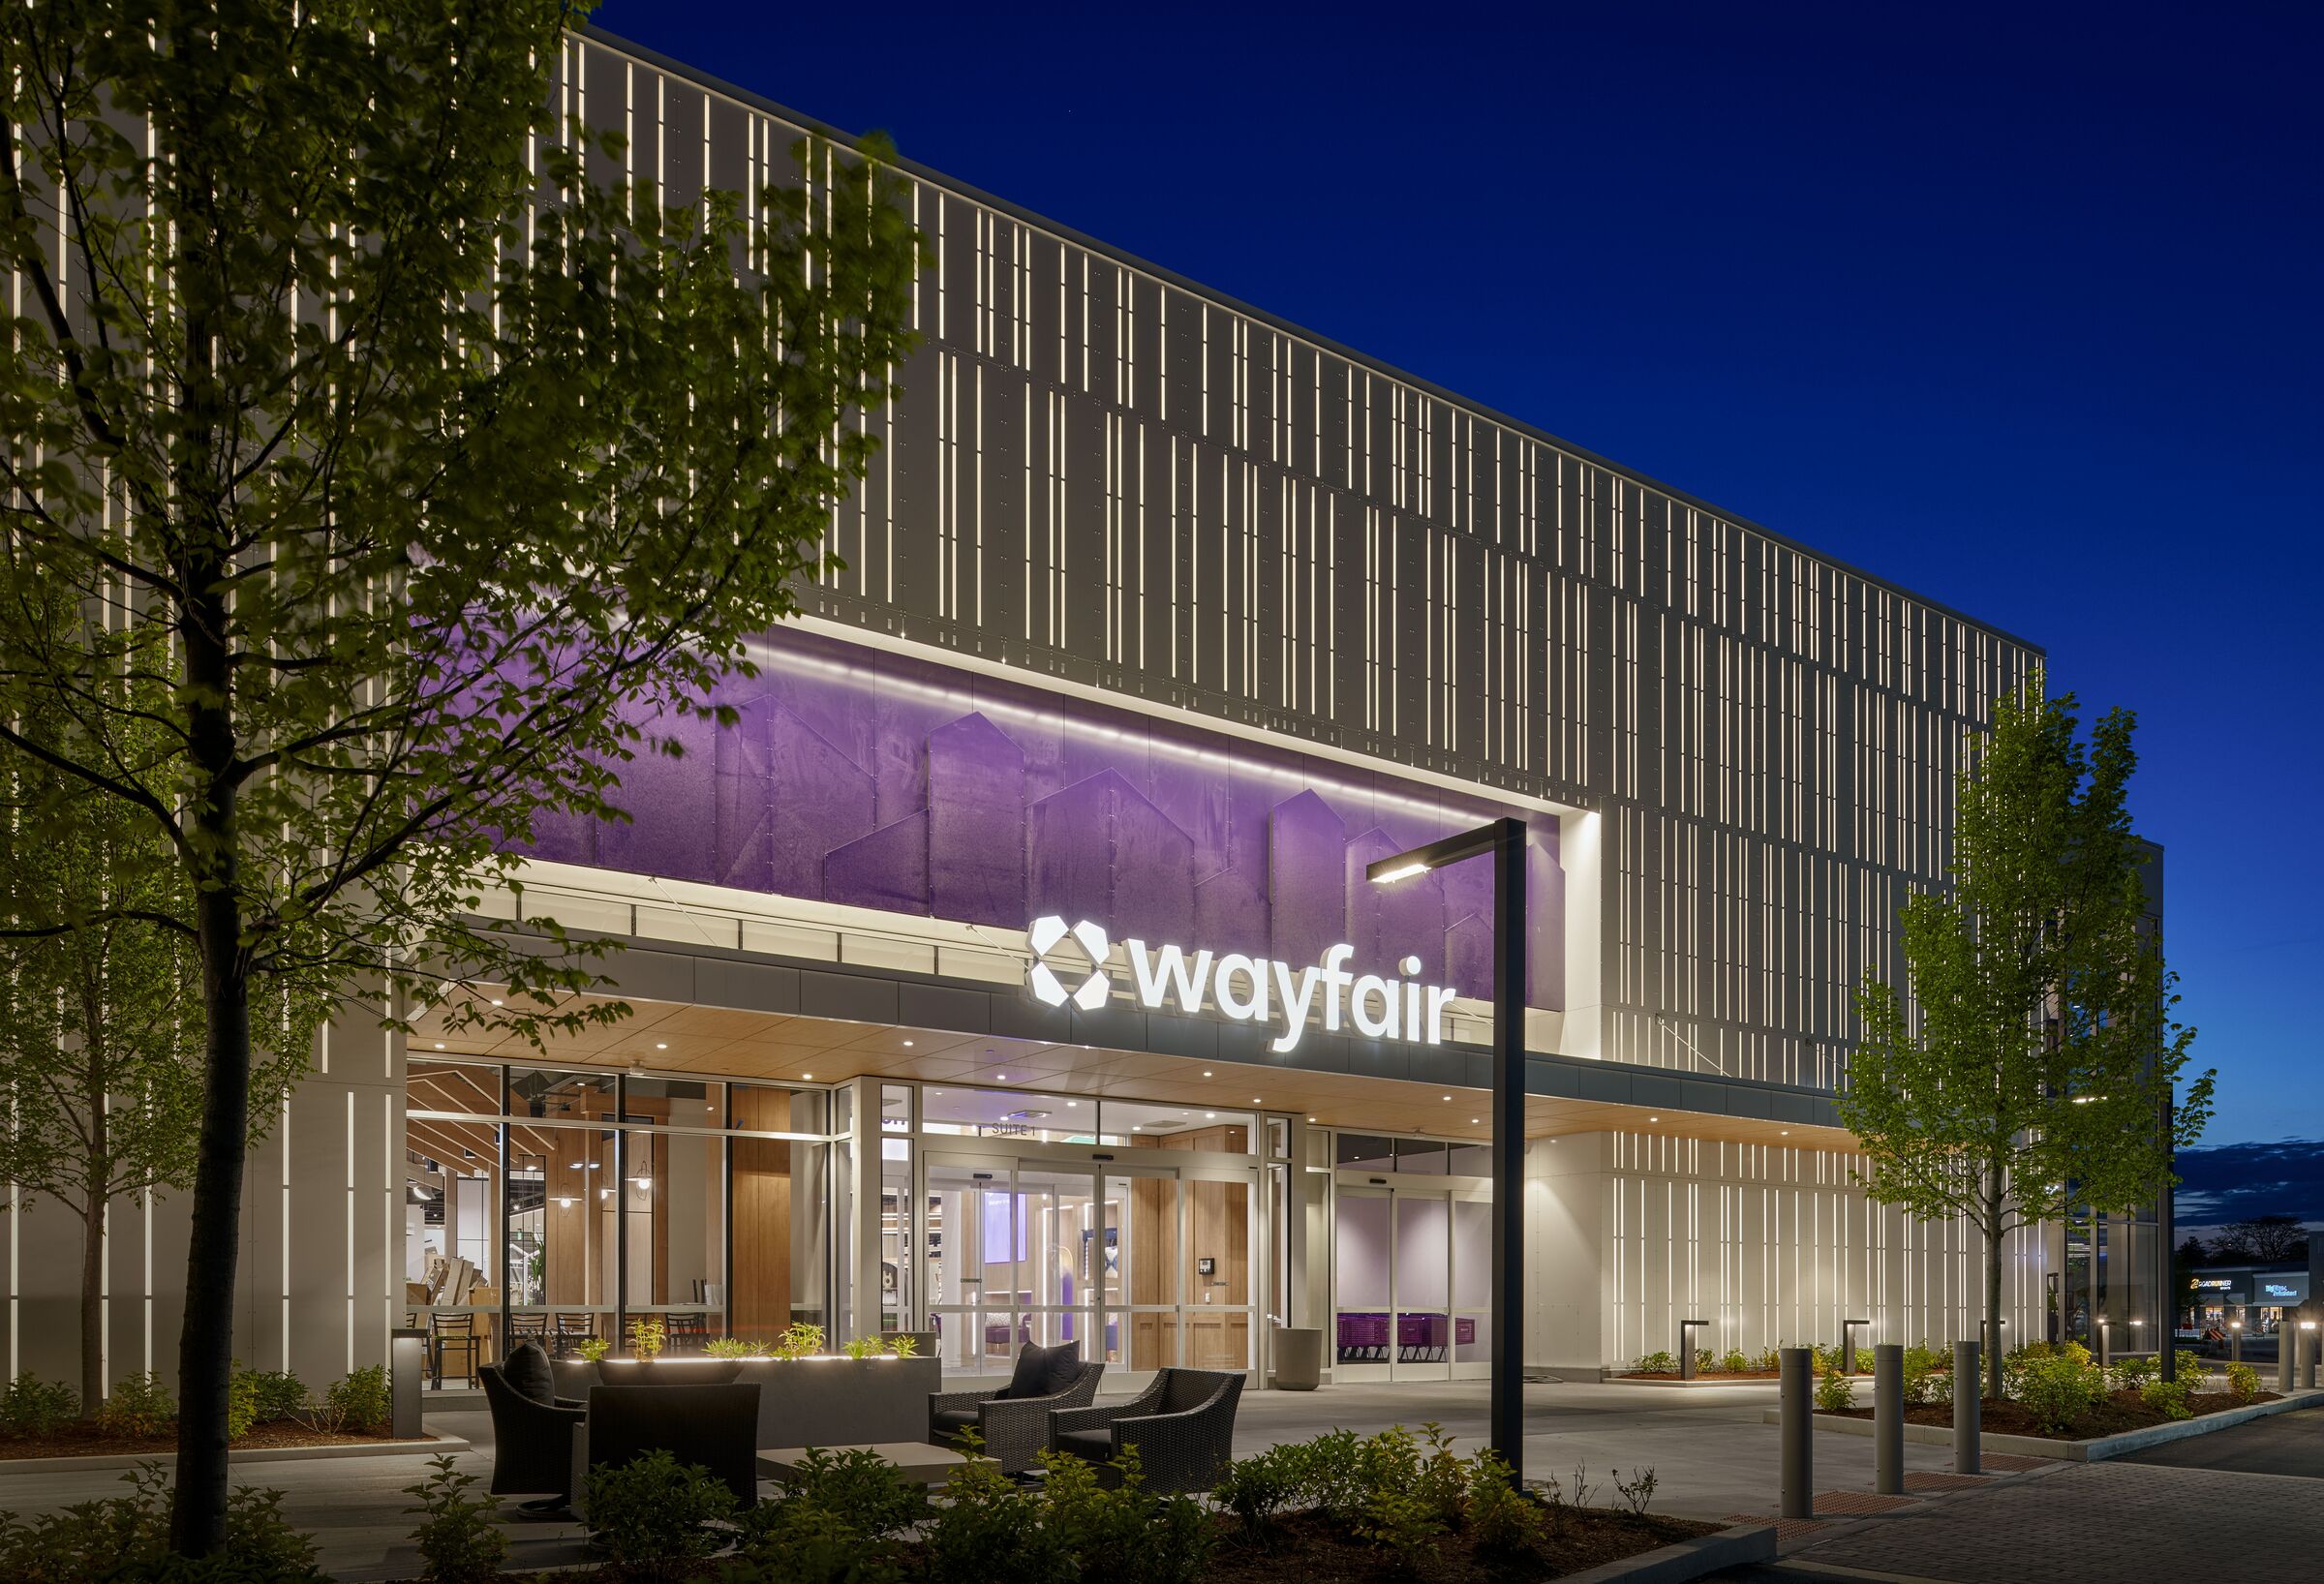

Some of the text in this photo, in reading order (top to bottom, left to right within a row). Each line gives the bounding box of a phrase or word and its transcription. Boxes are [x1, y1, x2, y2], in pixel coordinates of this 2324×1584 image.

[1123, 938, 1455, 1052] wayfair
[992, 1122, 1035, 1137] SUITE 1
